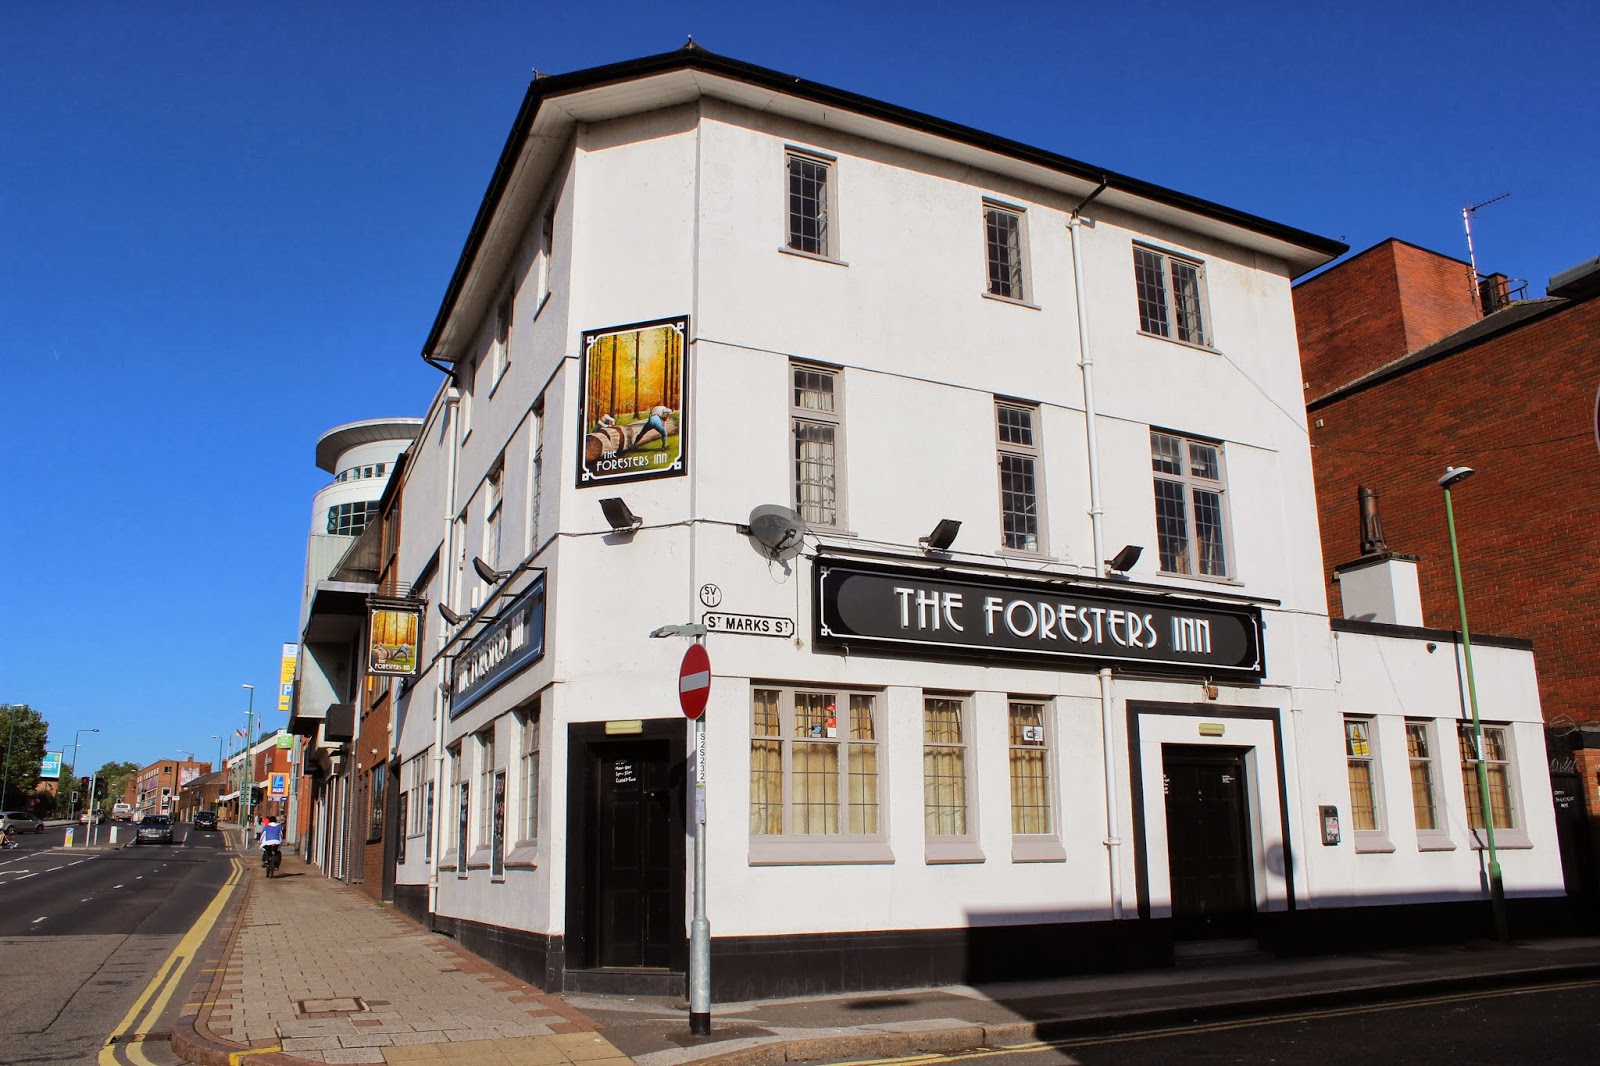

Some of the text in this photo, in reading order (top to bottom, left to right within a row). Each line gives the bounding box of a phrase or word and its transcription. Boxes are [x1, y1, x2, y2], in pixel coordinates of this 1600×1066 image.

[596, 453, 668, 471] FORESTERS INN
[603, 450, 618, 459] THE
[704, 586, 717, 595] SV
[726, 617, 770, 632] MARKS
[894, 587, 1212, 654] THE FORESTERS INN
